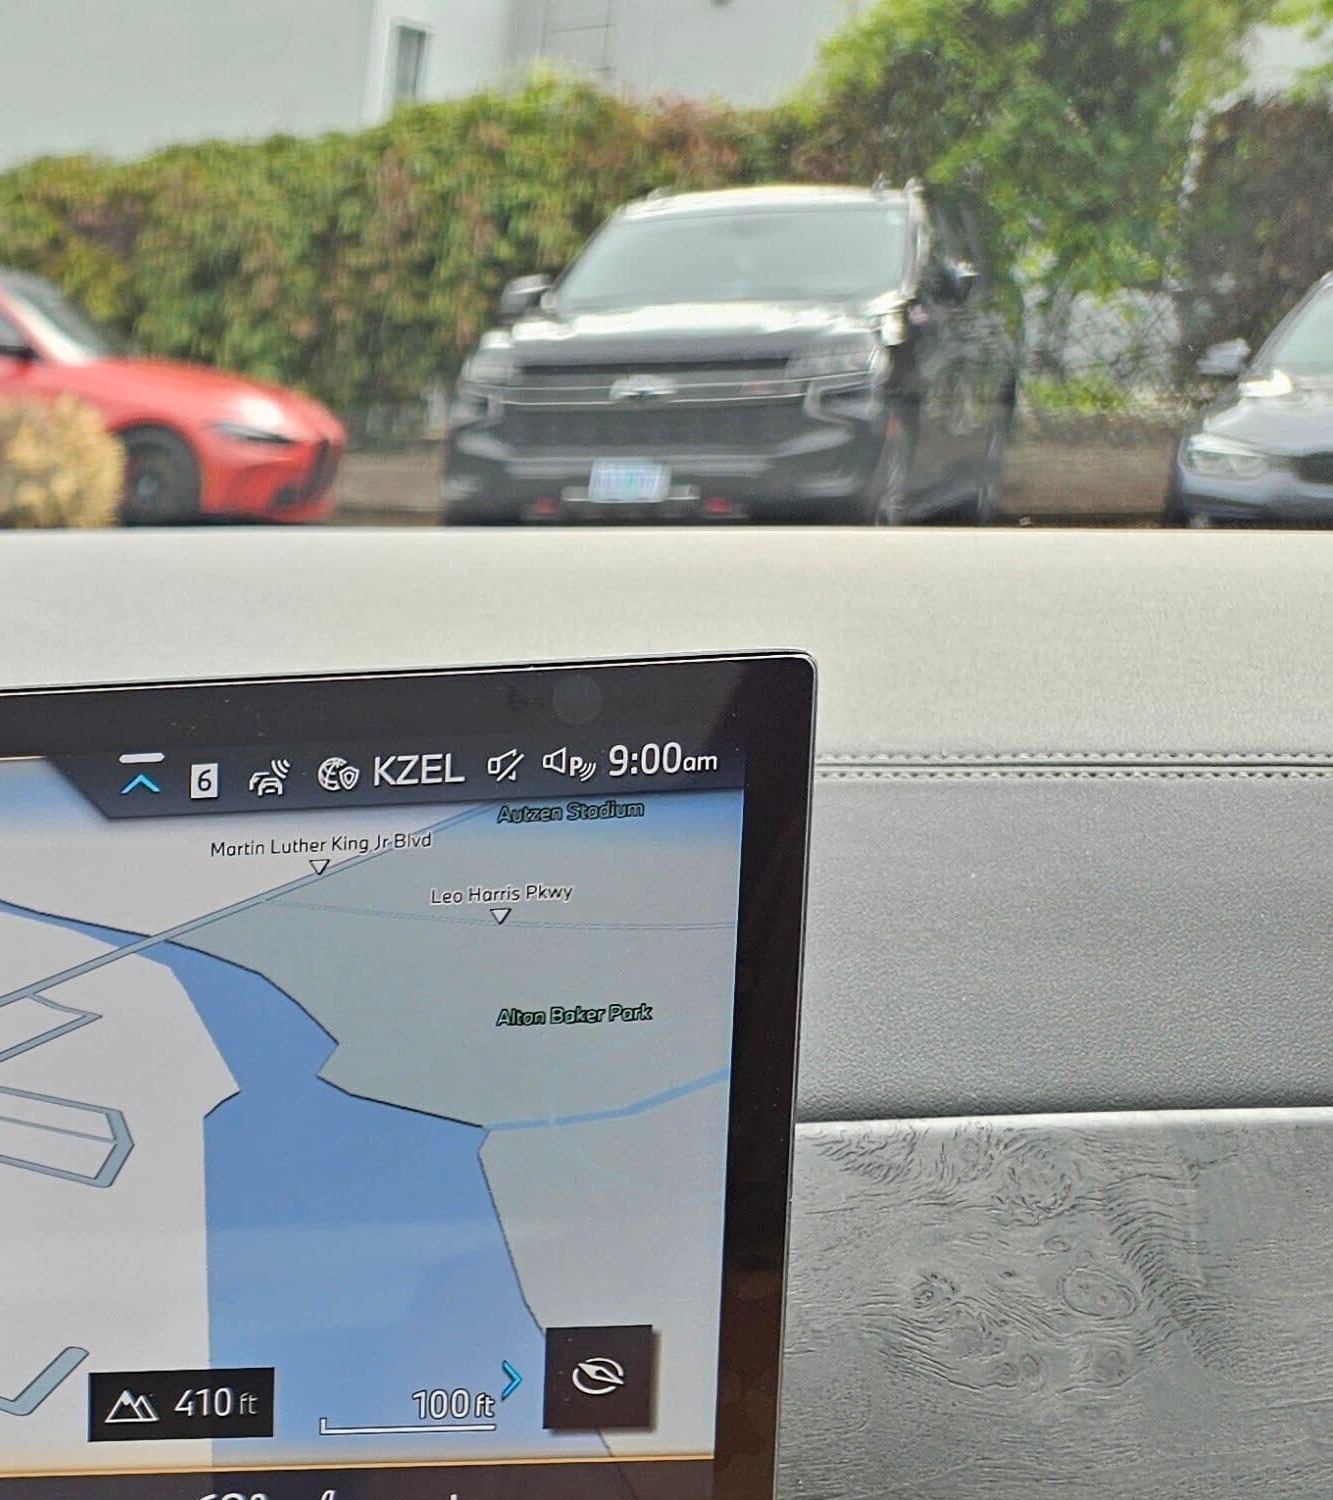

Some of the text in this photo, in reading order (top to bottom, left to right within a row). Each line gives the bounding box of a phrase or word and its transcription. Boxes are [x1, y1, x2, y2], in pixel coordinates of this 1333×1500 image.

[373, 754, 465, 786] KZEL
[608, 741, 718, 776] 9:00am
[198, 769, 211, 791] 6
[497, 801, 644, 823] Autzen Stadium
[211, 832, 431, 857] Martin Luther King Jr Blvd
[431, 885, 573, 905] Leo Harris Pkwy
[496, 1005, 652, 1027] Alton Baker Park
[174, 1387, 257, 1418] 410 ft
[412, 1389, 495, 1419] 100 ft
